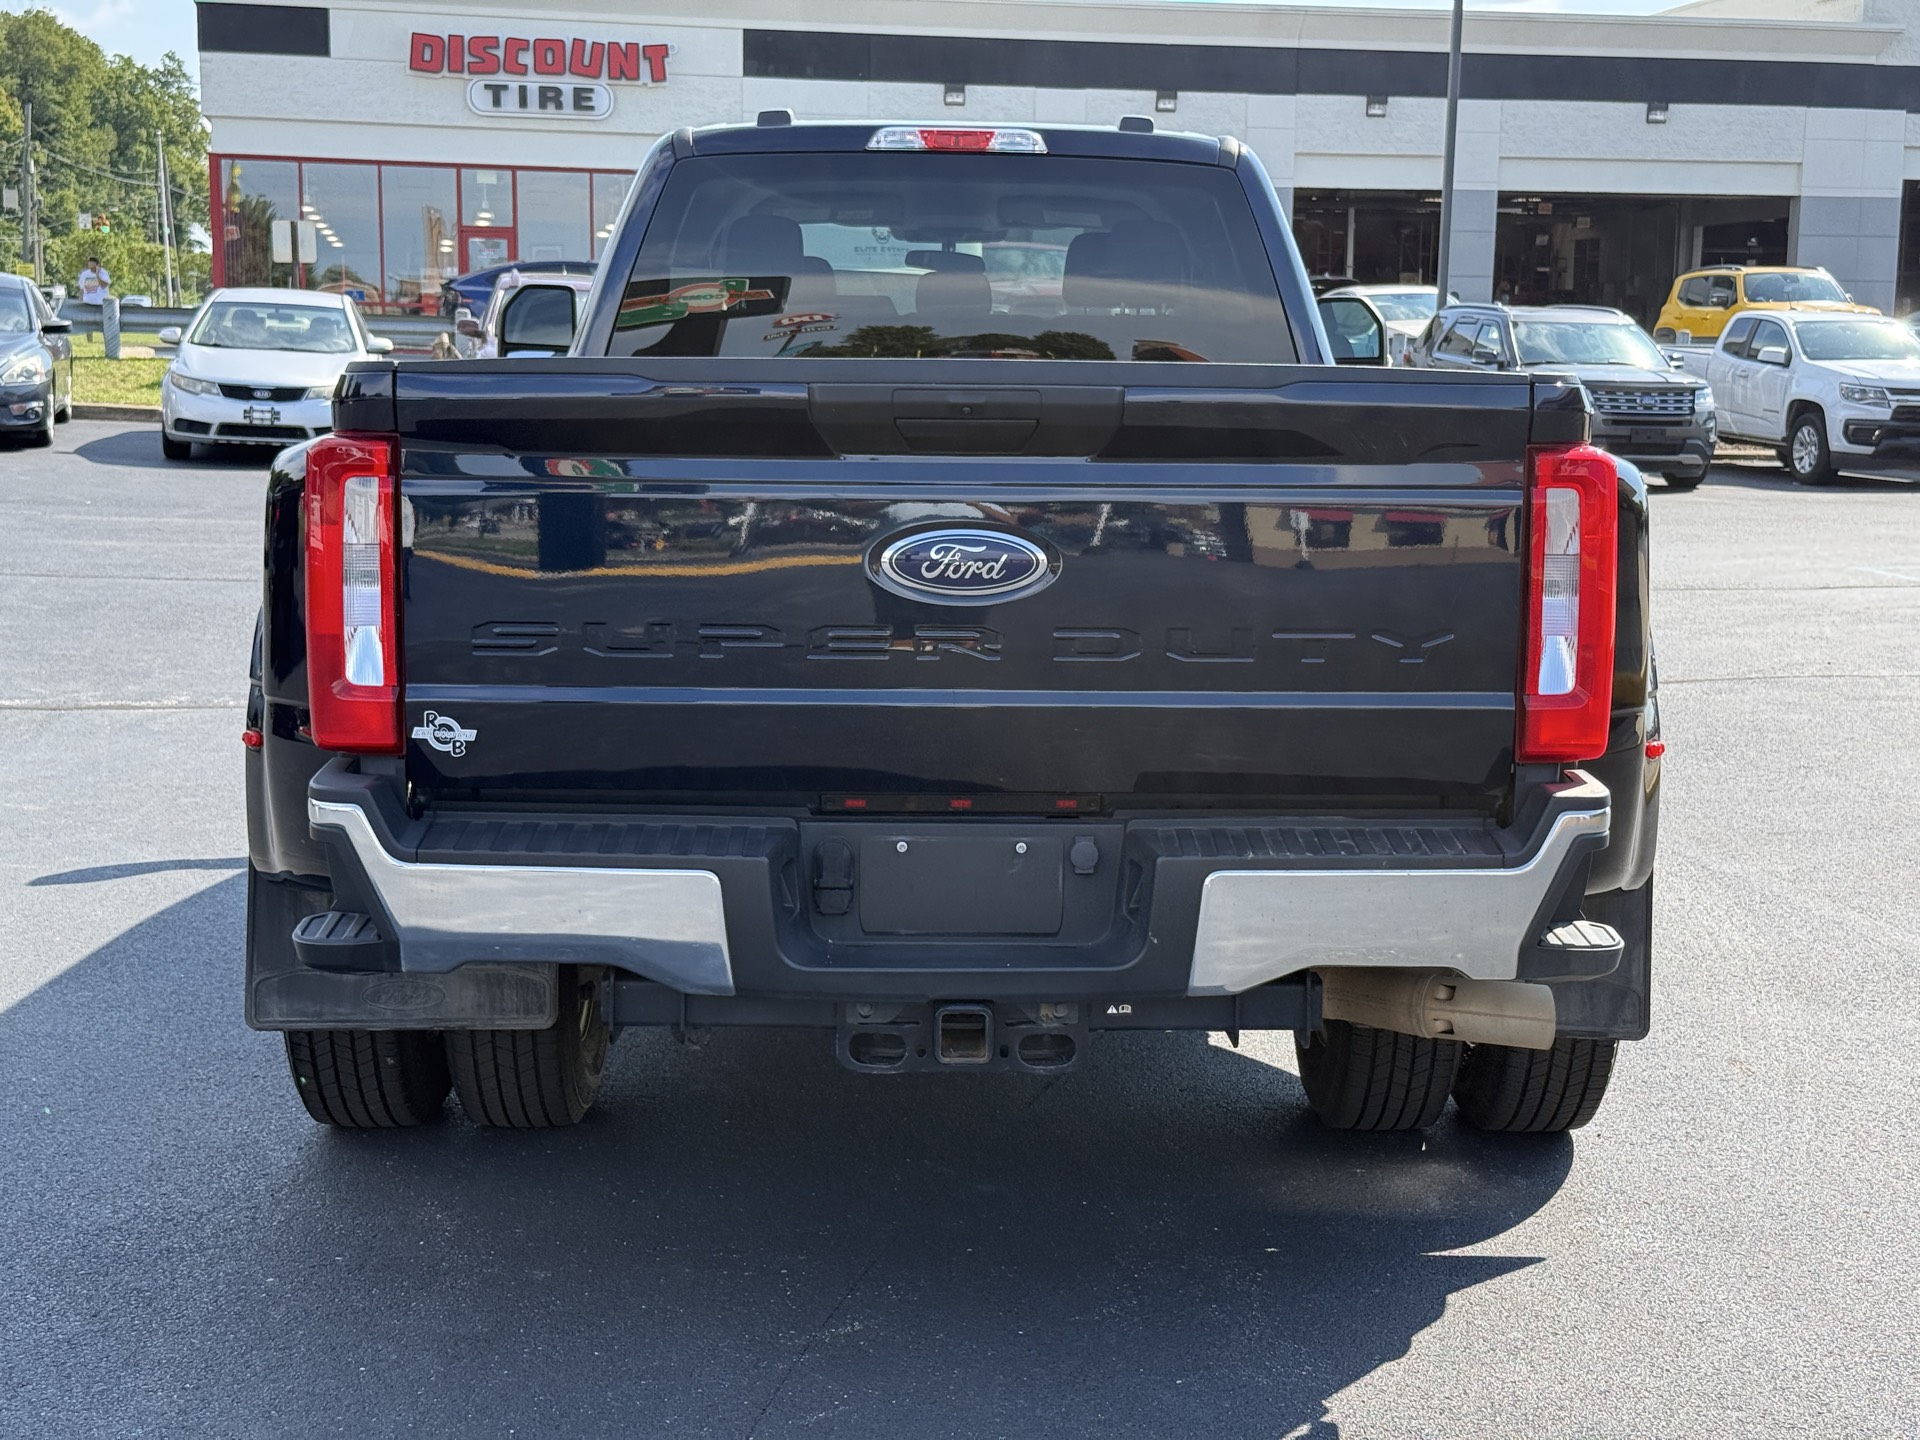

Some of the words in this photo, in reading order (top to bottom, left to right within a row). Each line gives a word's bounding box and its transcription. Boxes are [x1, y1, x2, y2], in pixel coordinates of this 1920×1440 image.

[409, 32, 669, 82] DISCOUNT
[484, 84, 596, 111] TIRE
[921, 544, 1009, 579] Ford
[471, 621, 1002, 661] SUPER
[1053, 627, 1455, 663] DUTY
